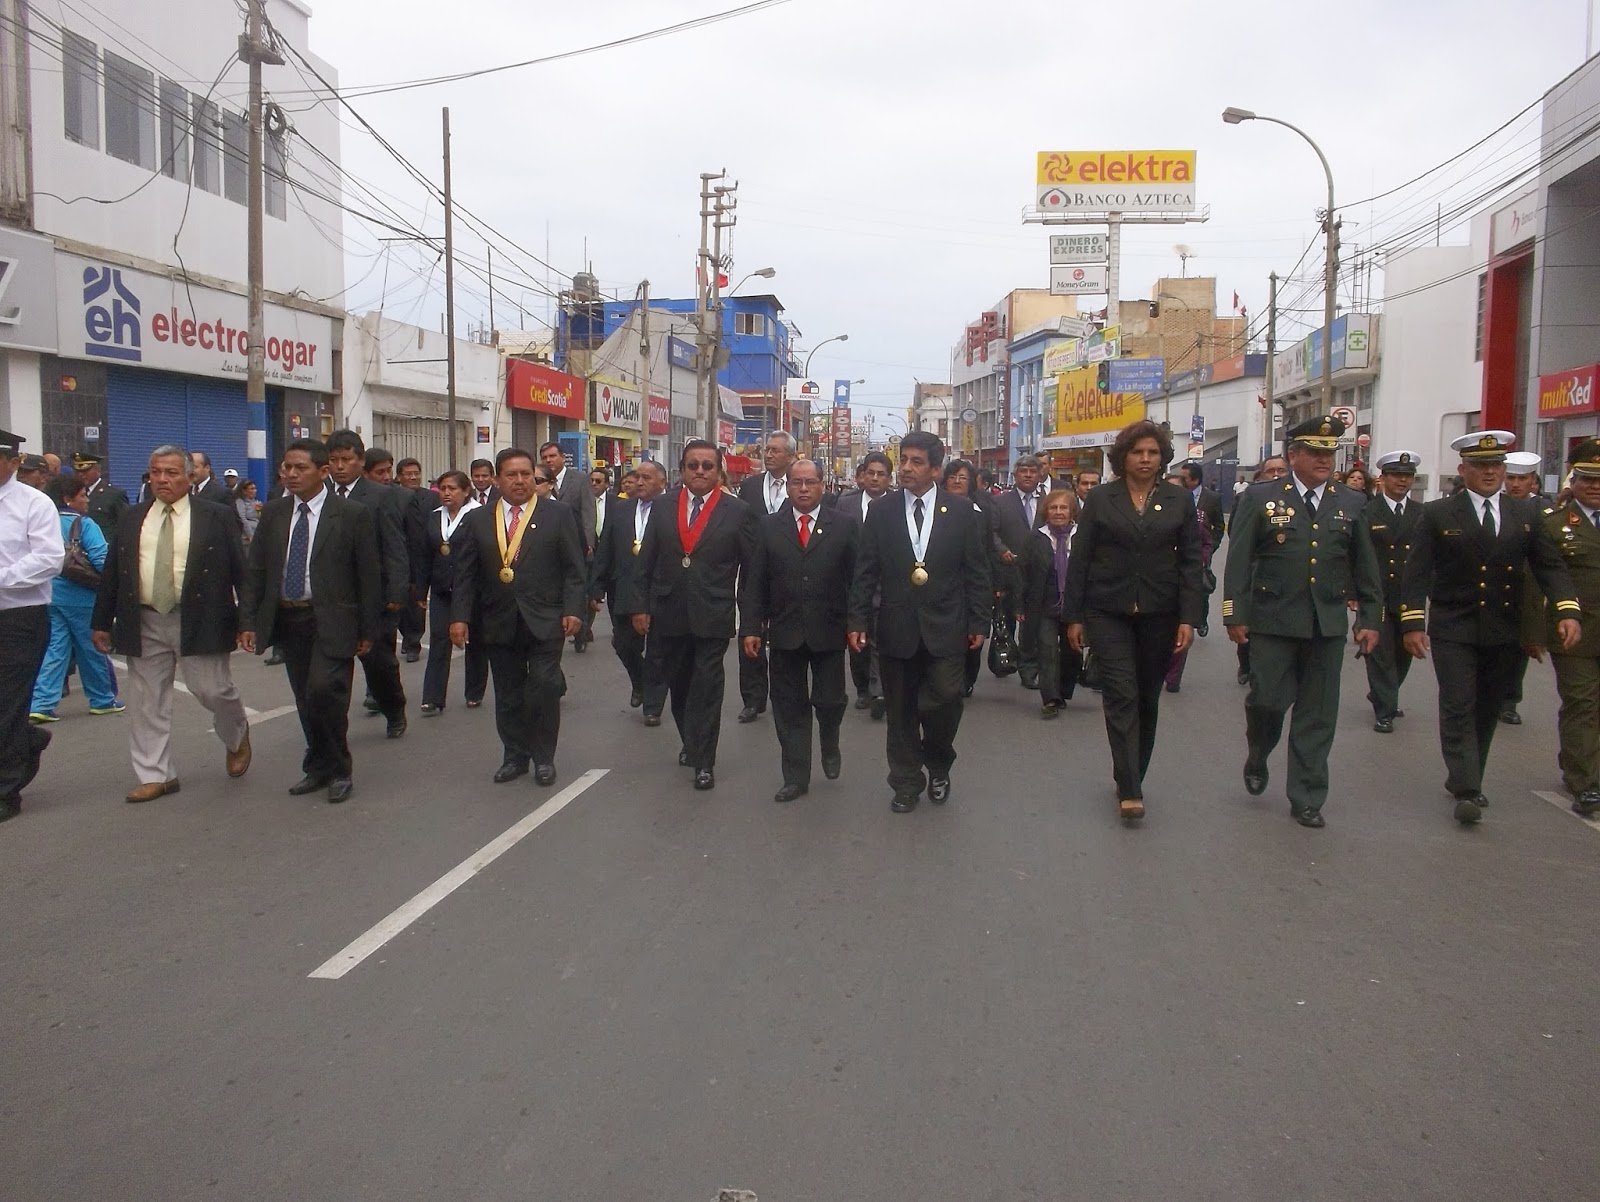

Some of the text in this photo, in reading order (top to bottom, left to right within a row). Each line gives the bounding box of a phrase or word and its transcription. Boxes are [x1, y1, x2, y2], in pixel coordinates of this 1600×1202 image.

[1079, 154, 1190, 182] elektra
[1074, 193, 1192, 206] BANCO AZTECA
[1053, 245, 1103, 254] EXPRESS
[1057, 236, 1099, 246] DINERO
[1057, 281, 1099, 289] MoneyGram
[85, 299, 141, 347] eh
[152, 307, 317, 372] electroogar
[530, 385, 567, 408] CrediScotia
[1541, 376, 1592, 410] multiRed
[612, 396, 640, 421] WALON
[835, 409, 850, 446] FOTOS
